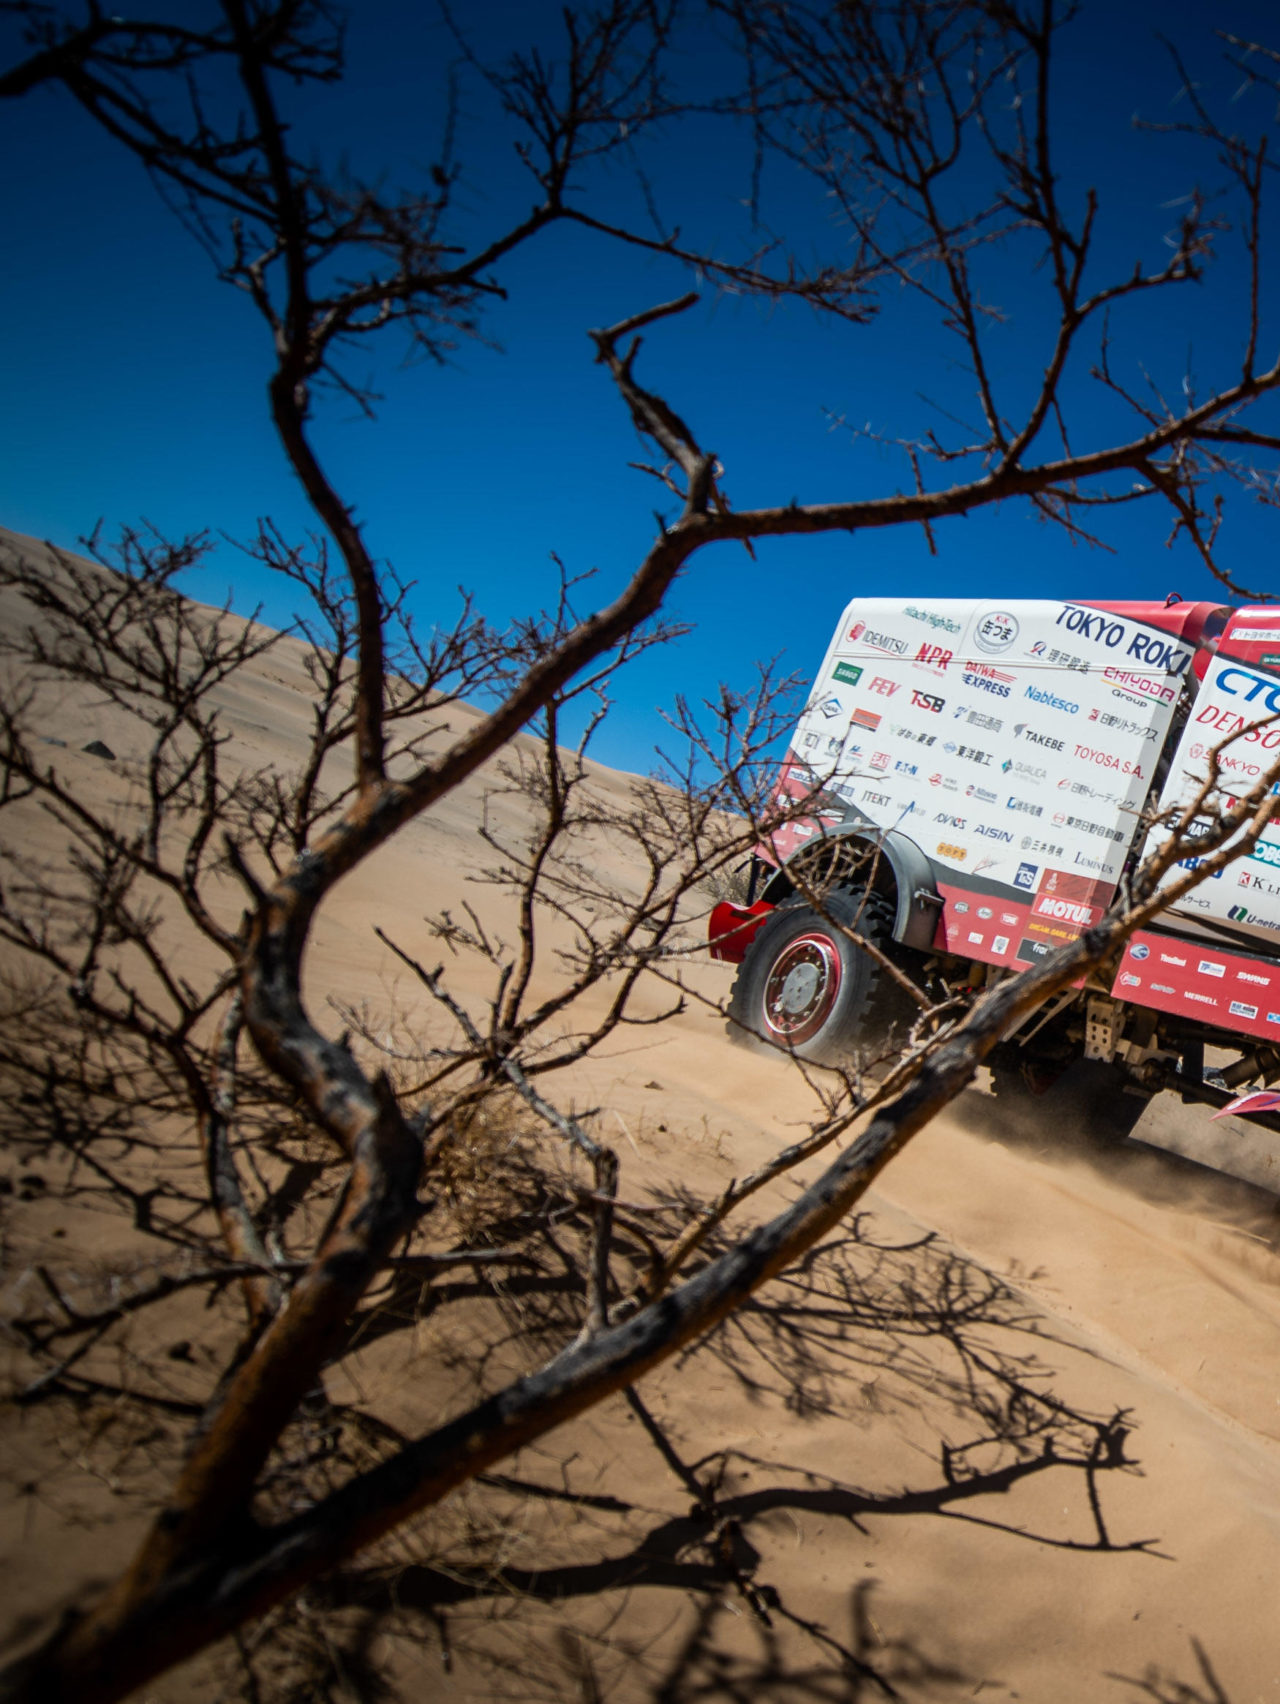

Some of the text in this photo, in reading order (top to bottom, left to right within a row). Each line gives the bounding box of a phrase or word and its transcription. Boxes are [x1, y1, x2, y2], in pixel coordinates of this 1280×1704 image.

[862, 630, 909, 655] IDEMITSU
[981, 620, 1013, 641] 缶つま
[1056, 605, 1192, 676] TOKYO ROKI
[914, 642, 953, 670] NPR
[965, 661, 996, 679] DAIWA
[868, 676, 902, 698] FEV
[961, 673, 1011, 698] EXPRESS
[1103, 666, 1176, 702] CHIYODA
[910, 689, 946, 713] TSB
[1024, 684, 1080, 715] Nabtesco
[1025, 730, 1065, 752] TAKEBE
[1074, 744, 1145, 780] TOYOSA S.A.
[861, 789, 892, 807] JTEKT
[973, 824, 1014, 843] AISIN
[1252, 876, 1265, 890] K
[1037, 897, 1093, 925] MOTUL
[1184, 991, 1218, 1006] MERRELL
